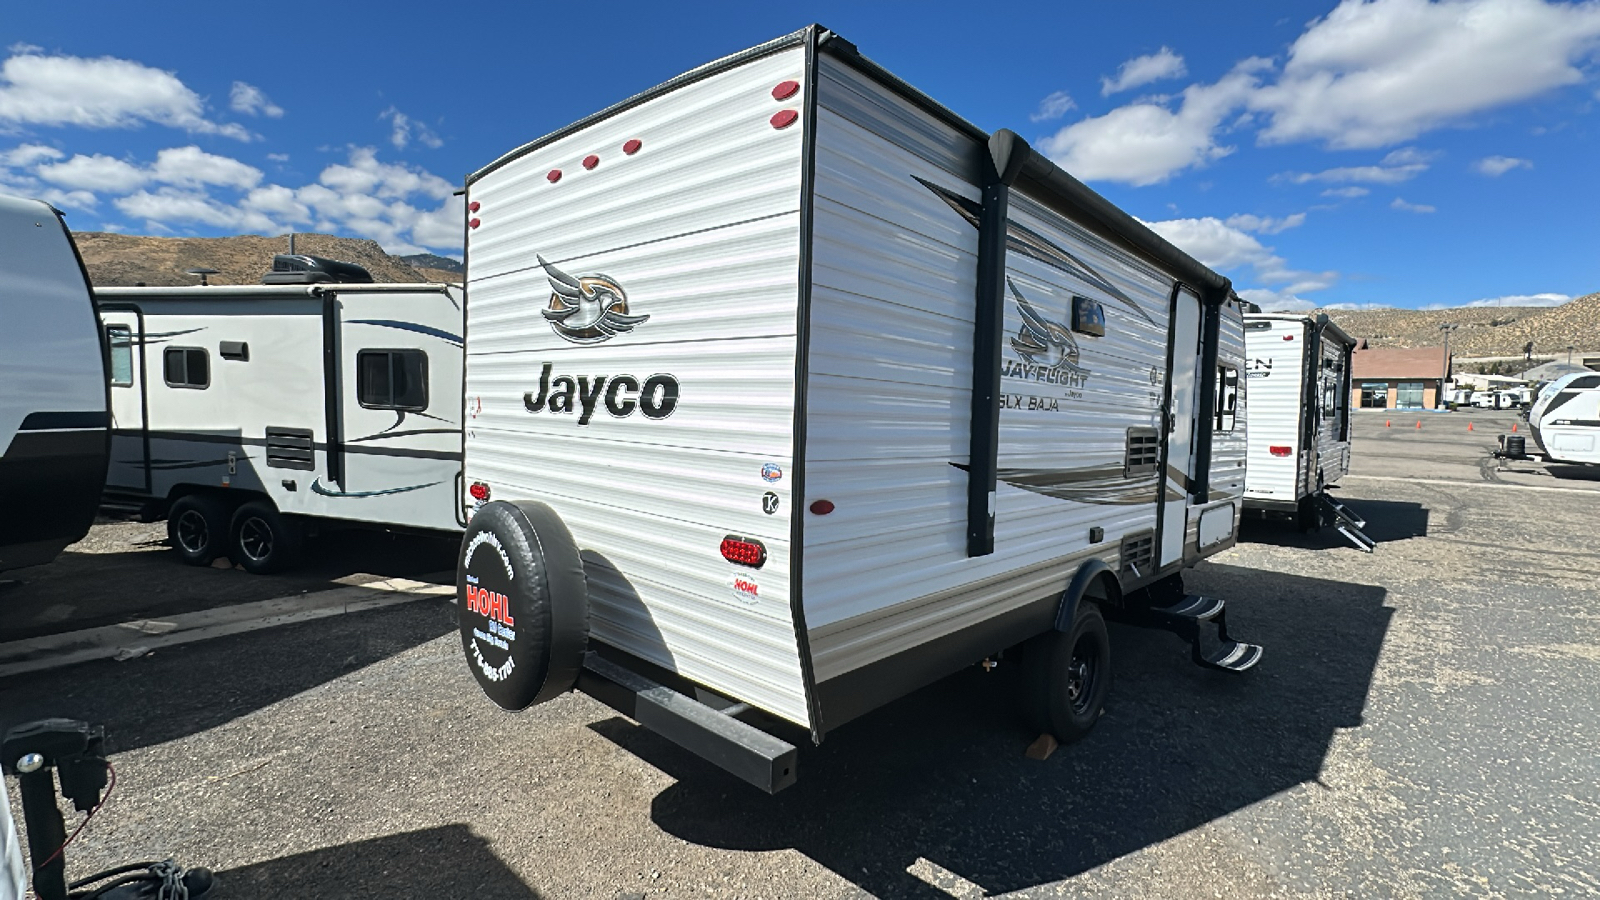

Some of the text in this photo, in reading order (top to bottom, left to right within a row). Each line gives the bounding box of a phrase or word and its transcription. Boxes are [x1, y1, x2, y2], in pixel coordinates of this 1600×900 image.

[1000, 359, 1089, 388] JAY FLIGHT
[523, 362, 681, 427] Jayco
[999, 394, 1059, 412] SLX BAJA
[763, 494, 779, 512] K
[734, 578, 758, 597] HOHL
[466, 584, 514, 626] HOHL
